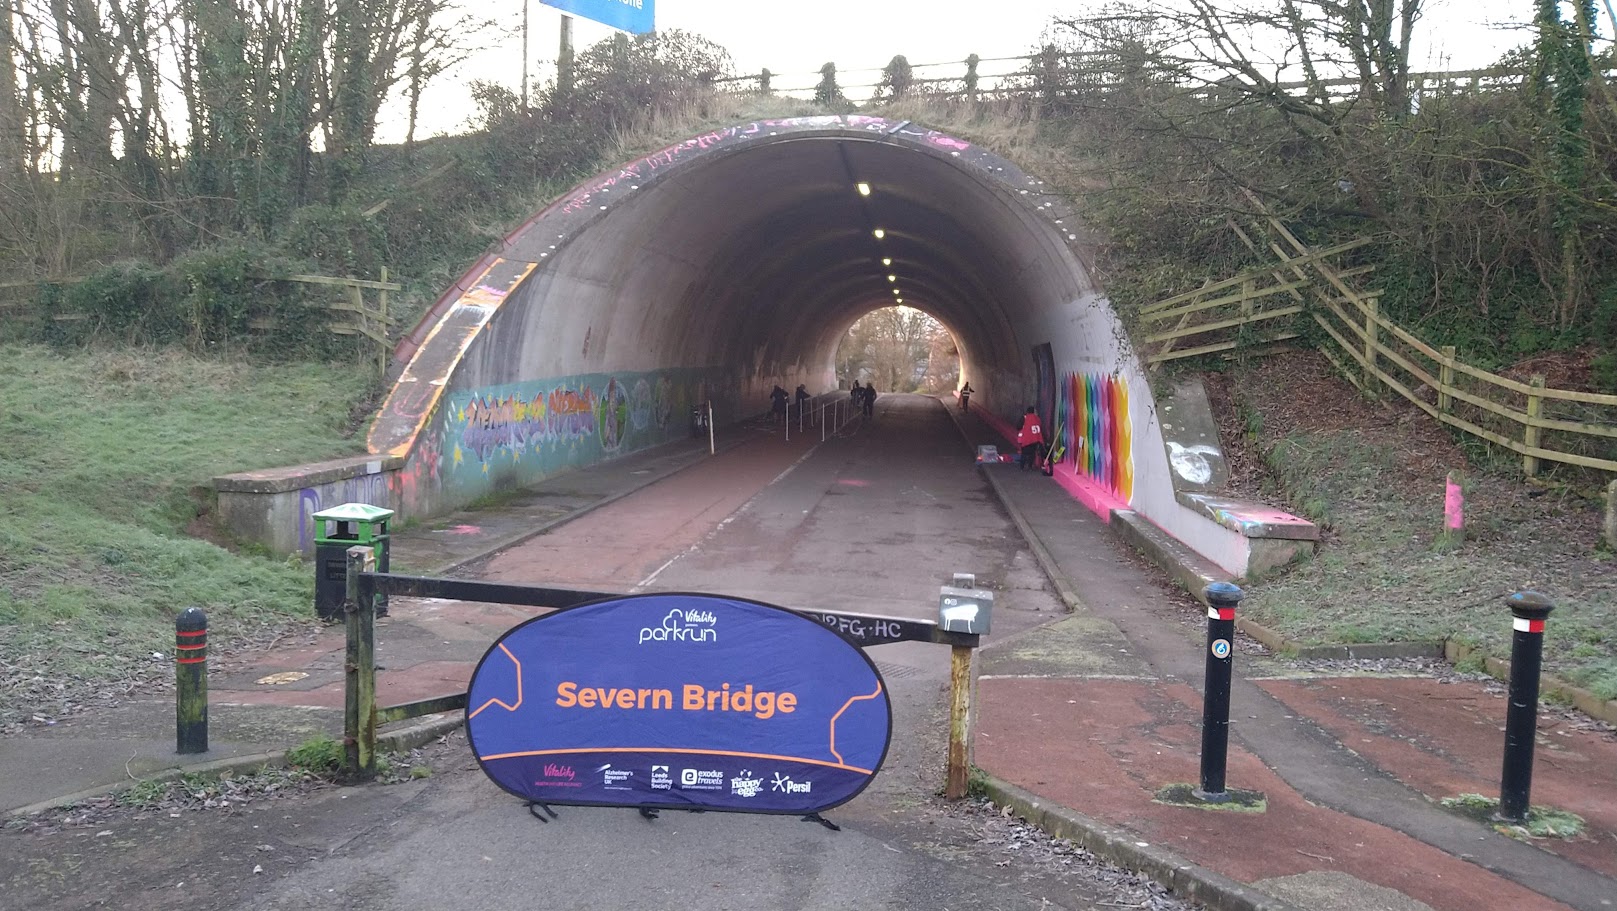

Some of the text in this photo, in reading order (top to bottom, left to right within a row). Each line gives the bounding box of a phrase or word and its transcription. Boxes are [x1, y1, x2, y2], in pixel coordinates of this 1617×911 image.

[685, 609, 717, 627] Vitality
[639, 619, 717, 645] parkrun
[556, 682, 798, 719] Severn Bridge
[544, 763, 575, 781] Vitality
[698, 770, 724, 778] exodus
[651, 783, 672, 791] Society
[697, 777, 723, 785] travels
[731, 778, 764, 788] happy
[786, 780, 812, 794] Persil
[738, 787, 757, 797] egg
